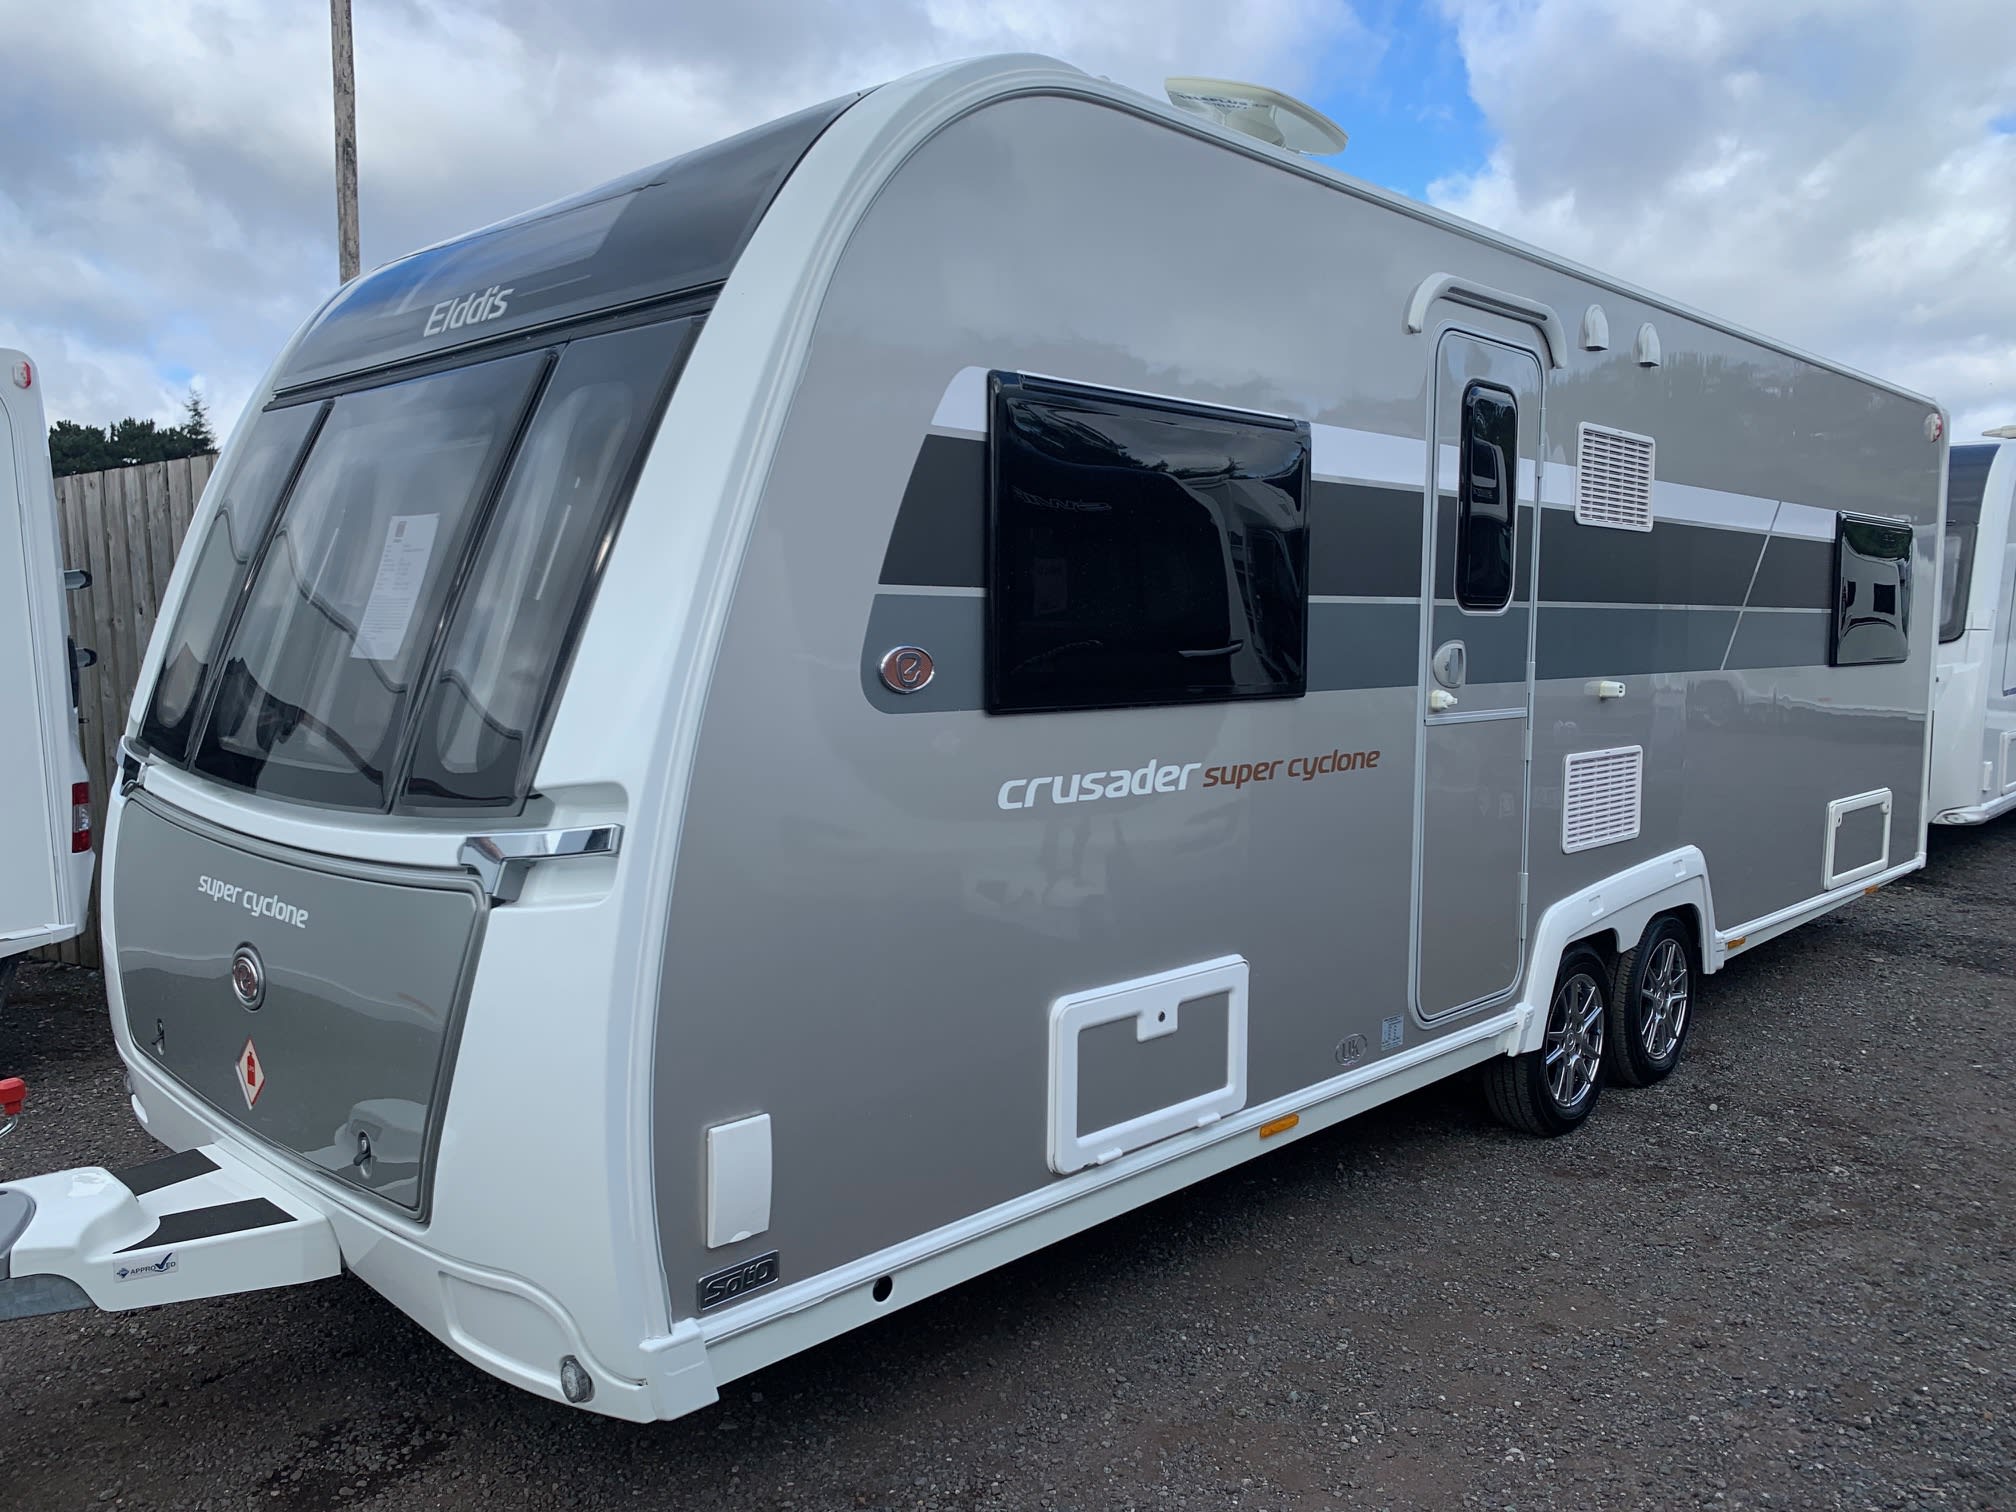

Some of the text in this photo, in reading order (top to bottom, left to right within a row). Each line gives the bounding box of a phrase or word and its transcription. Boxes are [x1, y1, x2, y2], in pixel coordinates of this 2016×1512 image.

[423, 284, 515, 337] Elddis
[998, 749, 1381, 810] crusader super cyclone
[197, 875, 309, 928] super cyclone
